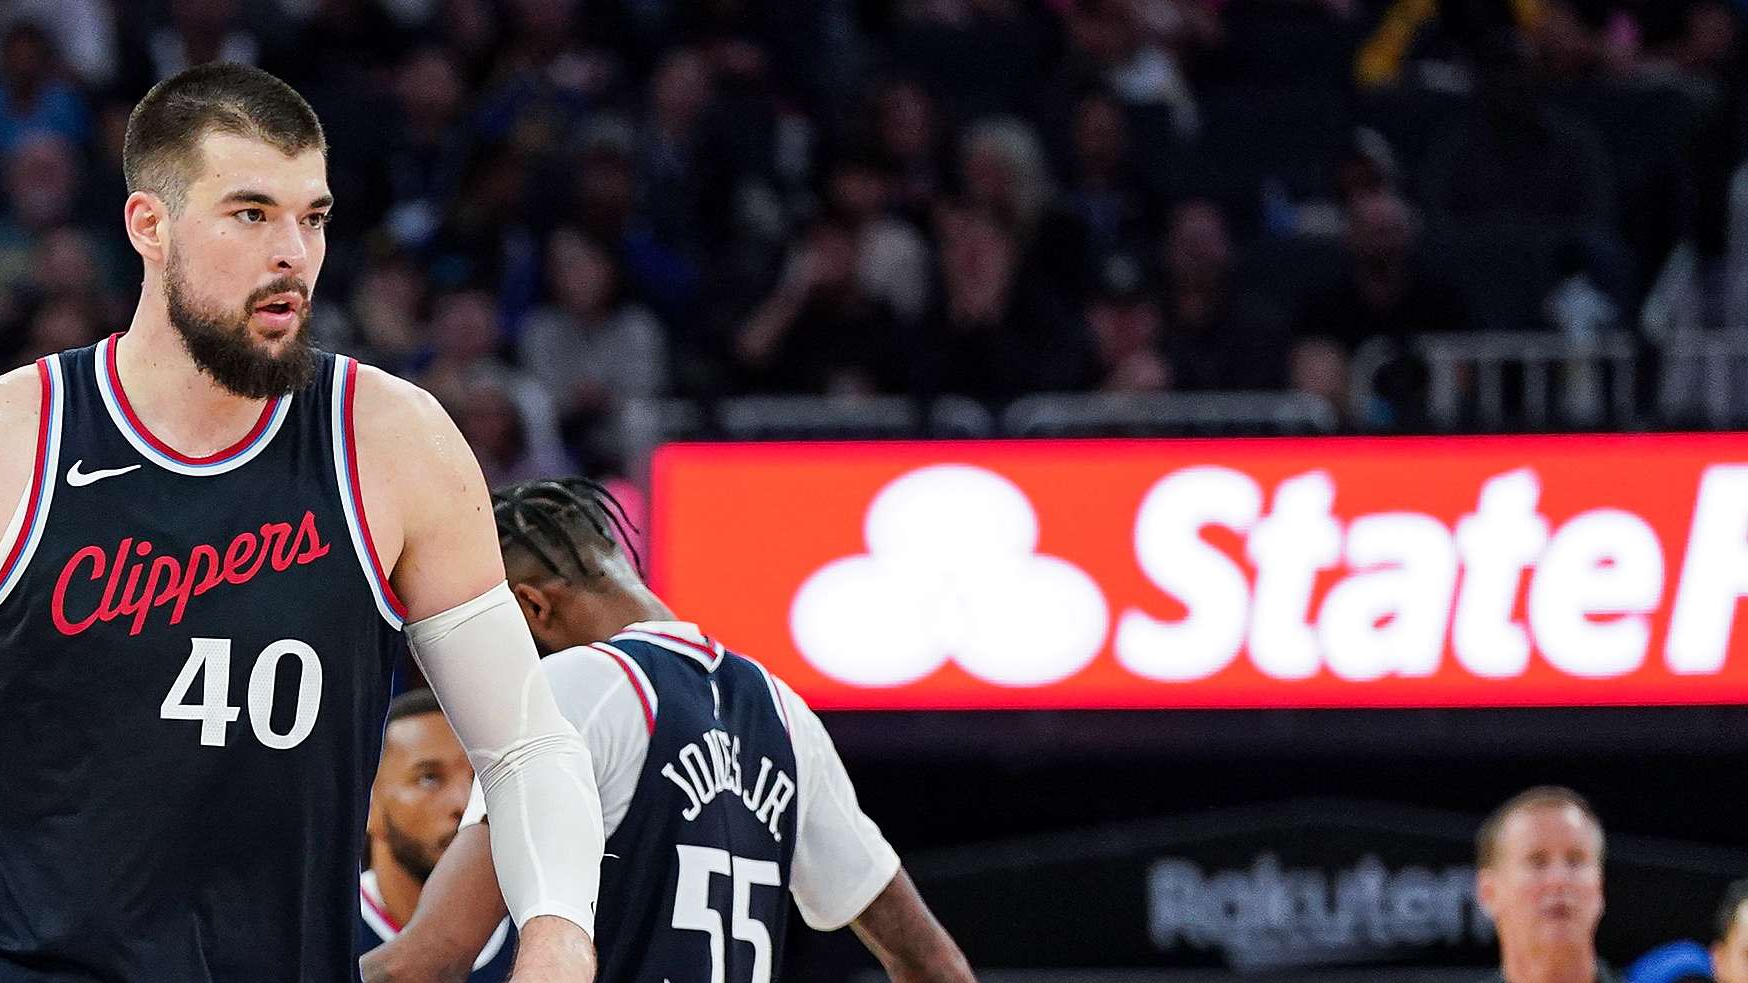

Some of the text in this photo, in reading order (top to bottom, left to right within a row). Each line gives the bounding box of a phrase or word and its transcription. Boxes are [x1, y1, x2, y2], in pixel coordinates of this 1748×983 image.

[51, 510, 331, 636] Clippers
[160, 637, 323, 750] 40
[661, 728, 743, 822] JONES
